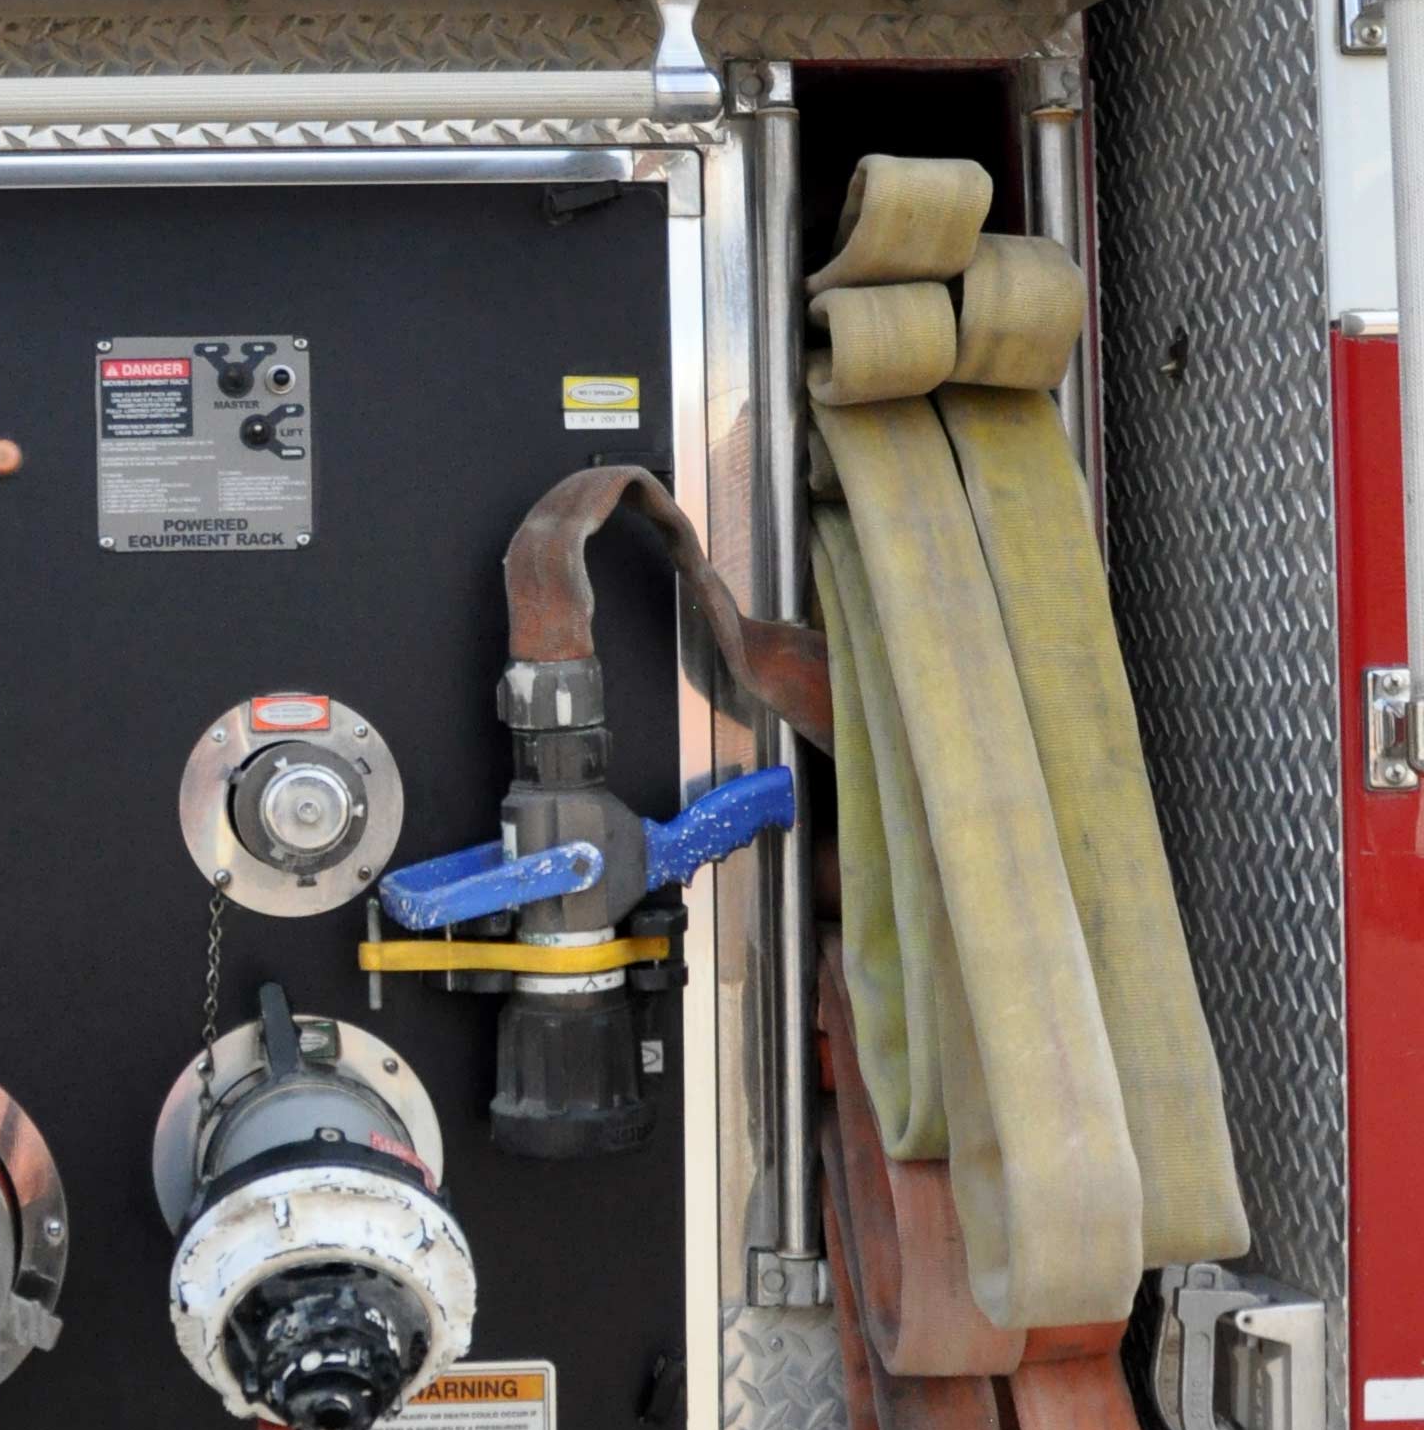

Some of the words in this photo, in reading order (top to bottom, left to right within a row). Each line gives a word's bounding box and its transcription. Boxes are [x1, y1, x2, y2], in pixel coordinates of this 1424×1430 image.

[121, 363, 183, 376] DANGER
[214, 401, 260, 409] MASTER
[280, 428, 304, 437] LIFT
[163, 518, 248, 532] POWERED
[128, 533, 230, 548] EQUIPMENT
[236, 532, 284, 546] RACK
[443, 1411, 469, 1419] DEATH
[471, 1411, 498, 1419] COULD
